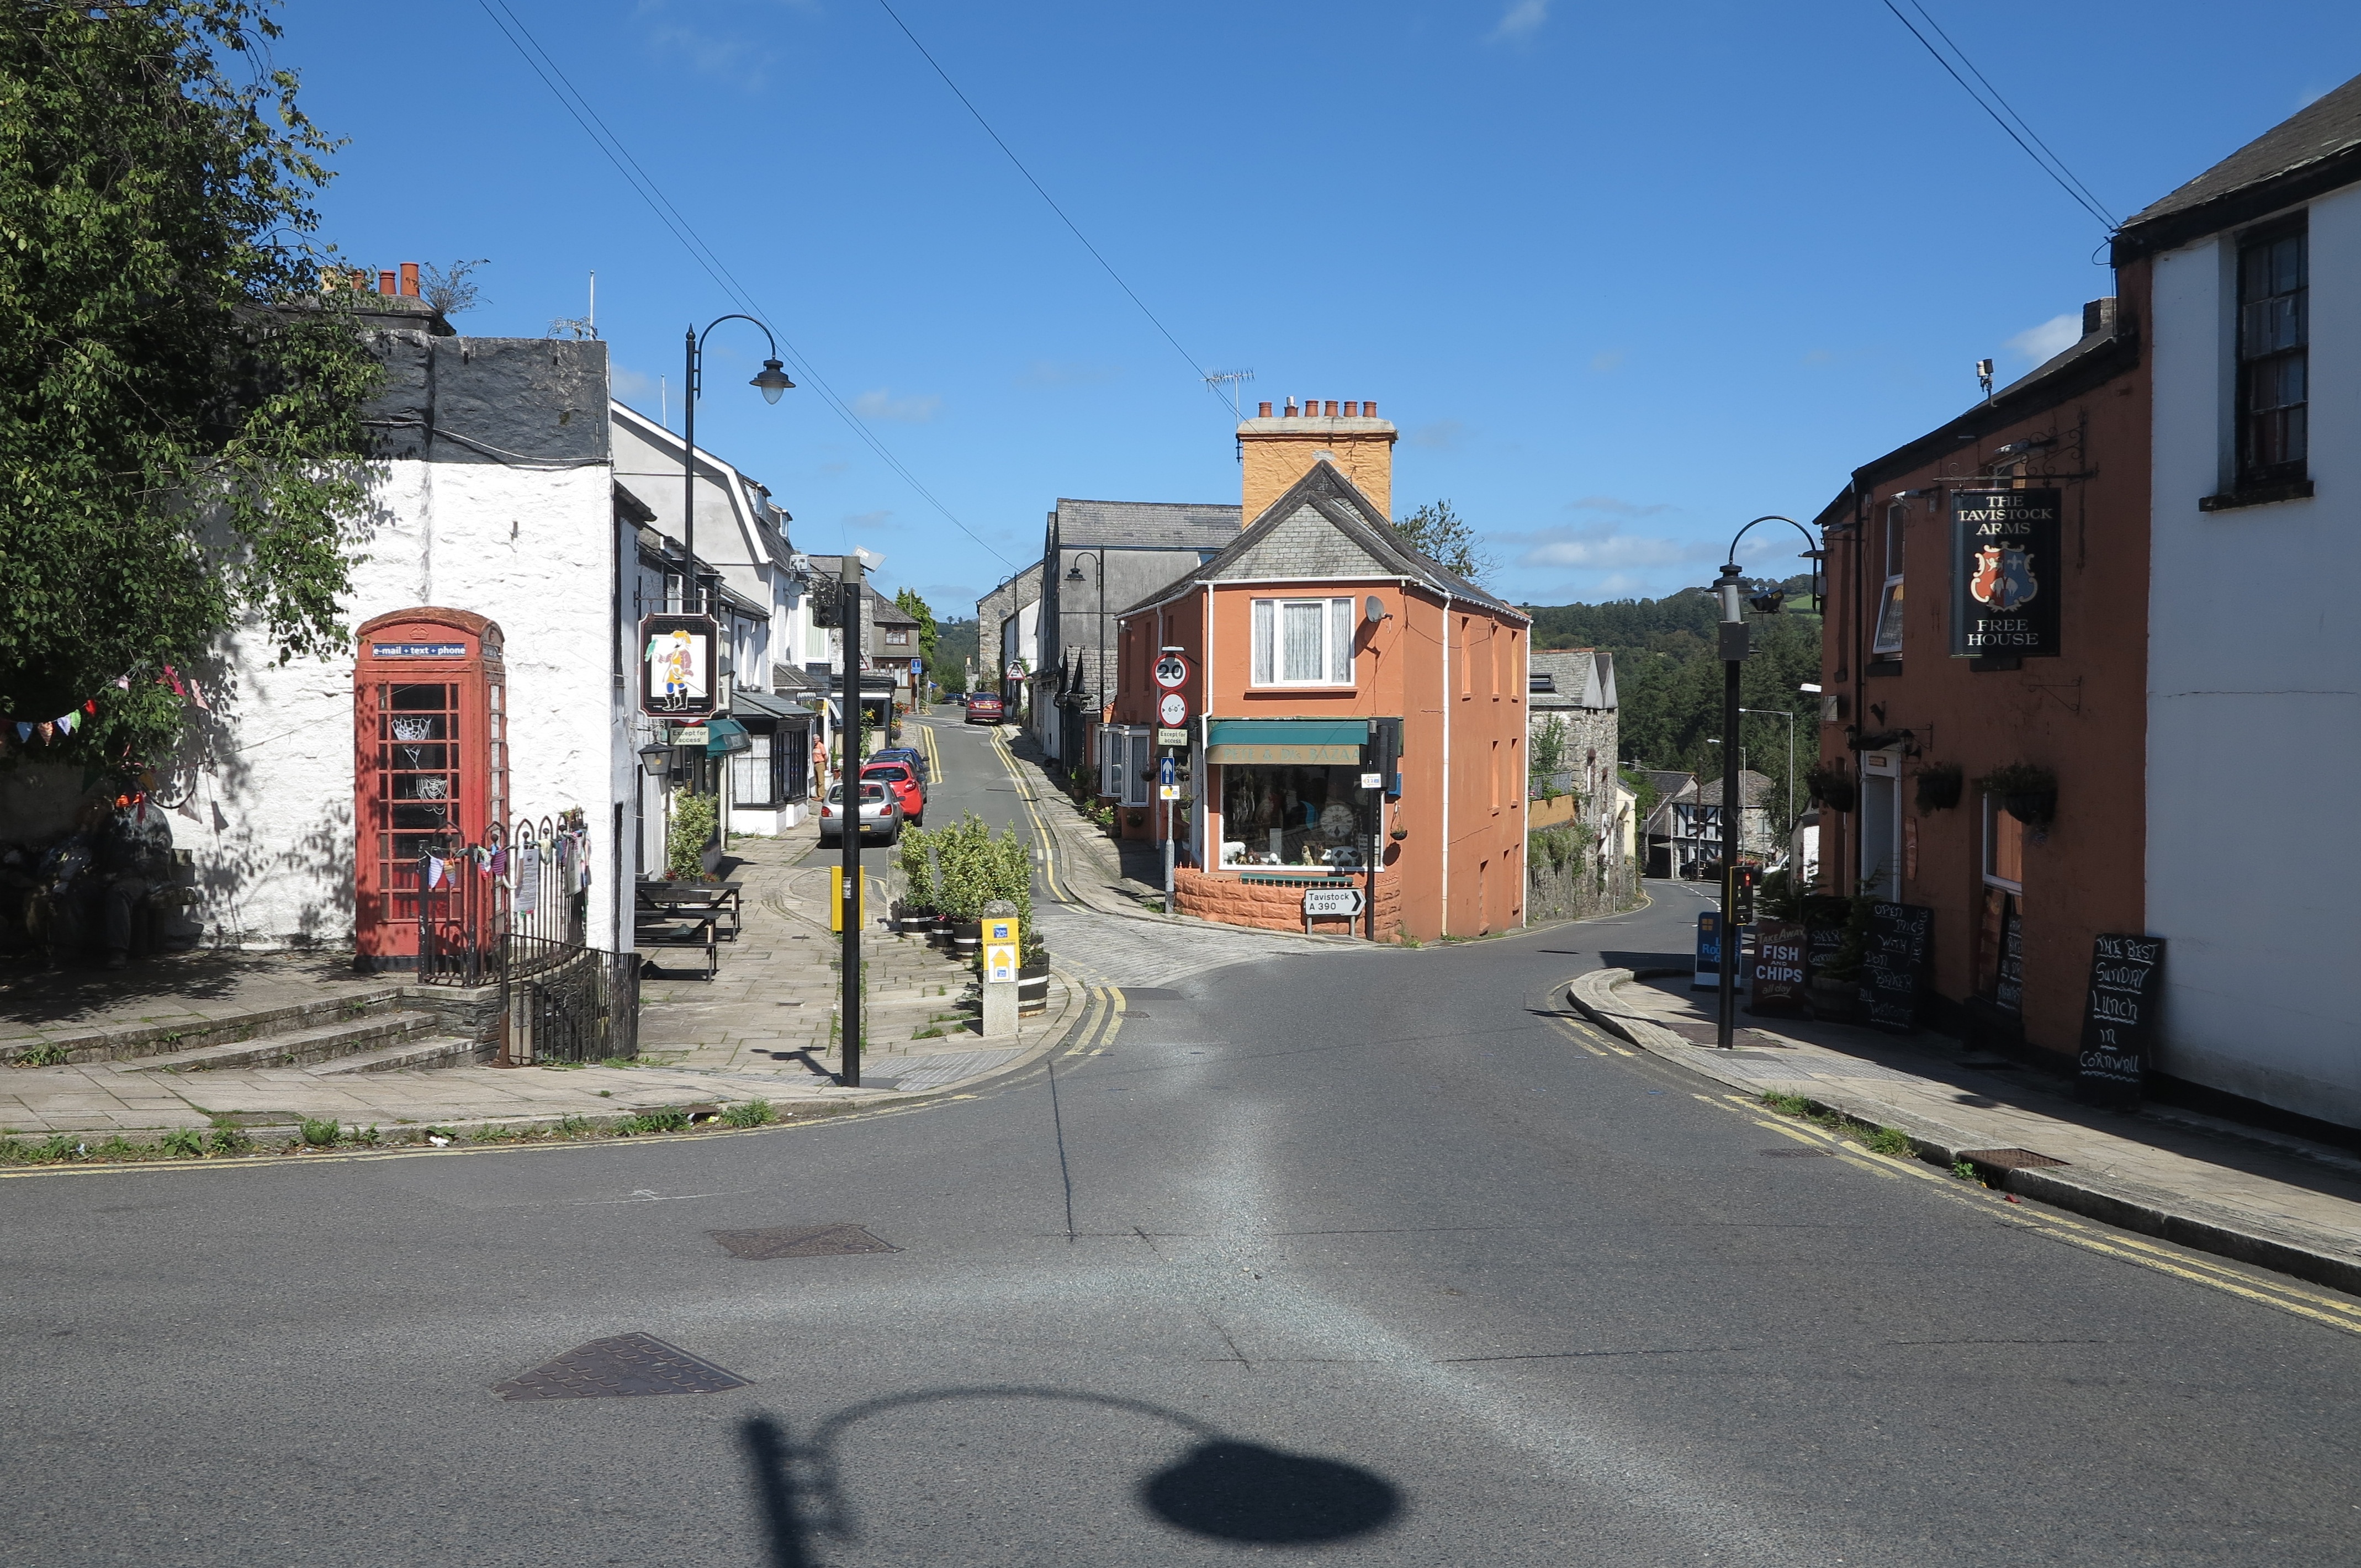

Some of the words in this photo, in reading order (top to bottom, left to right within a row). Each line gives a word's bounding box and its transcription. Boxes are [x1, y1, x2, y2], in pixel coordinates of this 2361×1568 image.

[1986, 496, 2024, 508] THE
[1957, 508, 2053, 522] TAVISTOCK
[1976, 522, 2031, 536] ARMS
[1977, 619, 2029, 632] FREE
[1967, 633, 2039, 646] HOUSE
[373, 646, 402, 655] e-mail
[410, 647, 430, 655] text
[437, 645, 466, 656] phone
[1158, 664, 1184, 680] 20
[1224, 748, 1255, 760] PETE
[1262, 749, 1272, 760] &
[1309, 893, 1349, 901] Tavistock
[1318, 902, 1336, 910] 390
[1812, 930, 1840, 942] BEER
[1762, 945, 1799, 961] FISH
[2096, 936, 2121, 955] THE
[2125, 940, 2159, 959] BEST
[1756, 965, 1803, 983] CHIPS
[1762, 984, 1774, 994] all
[1775, 983, 1792, 994] day
